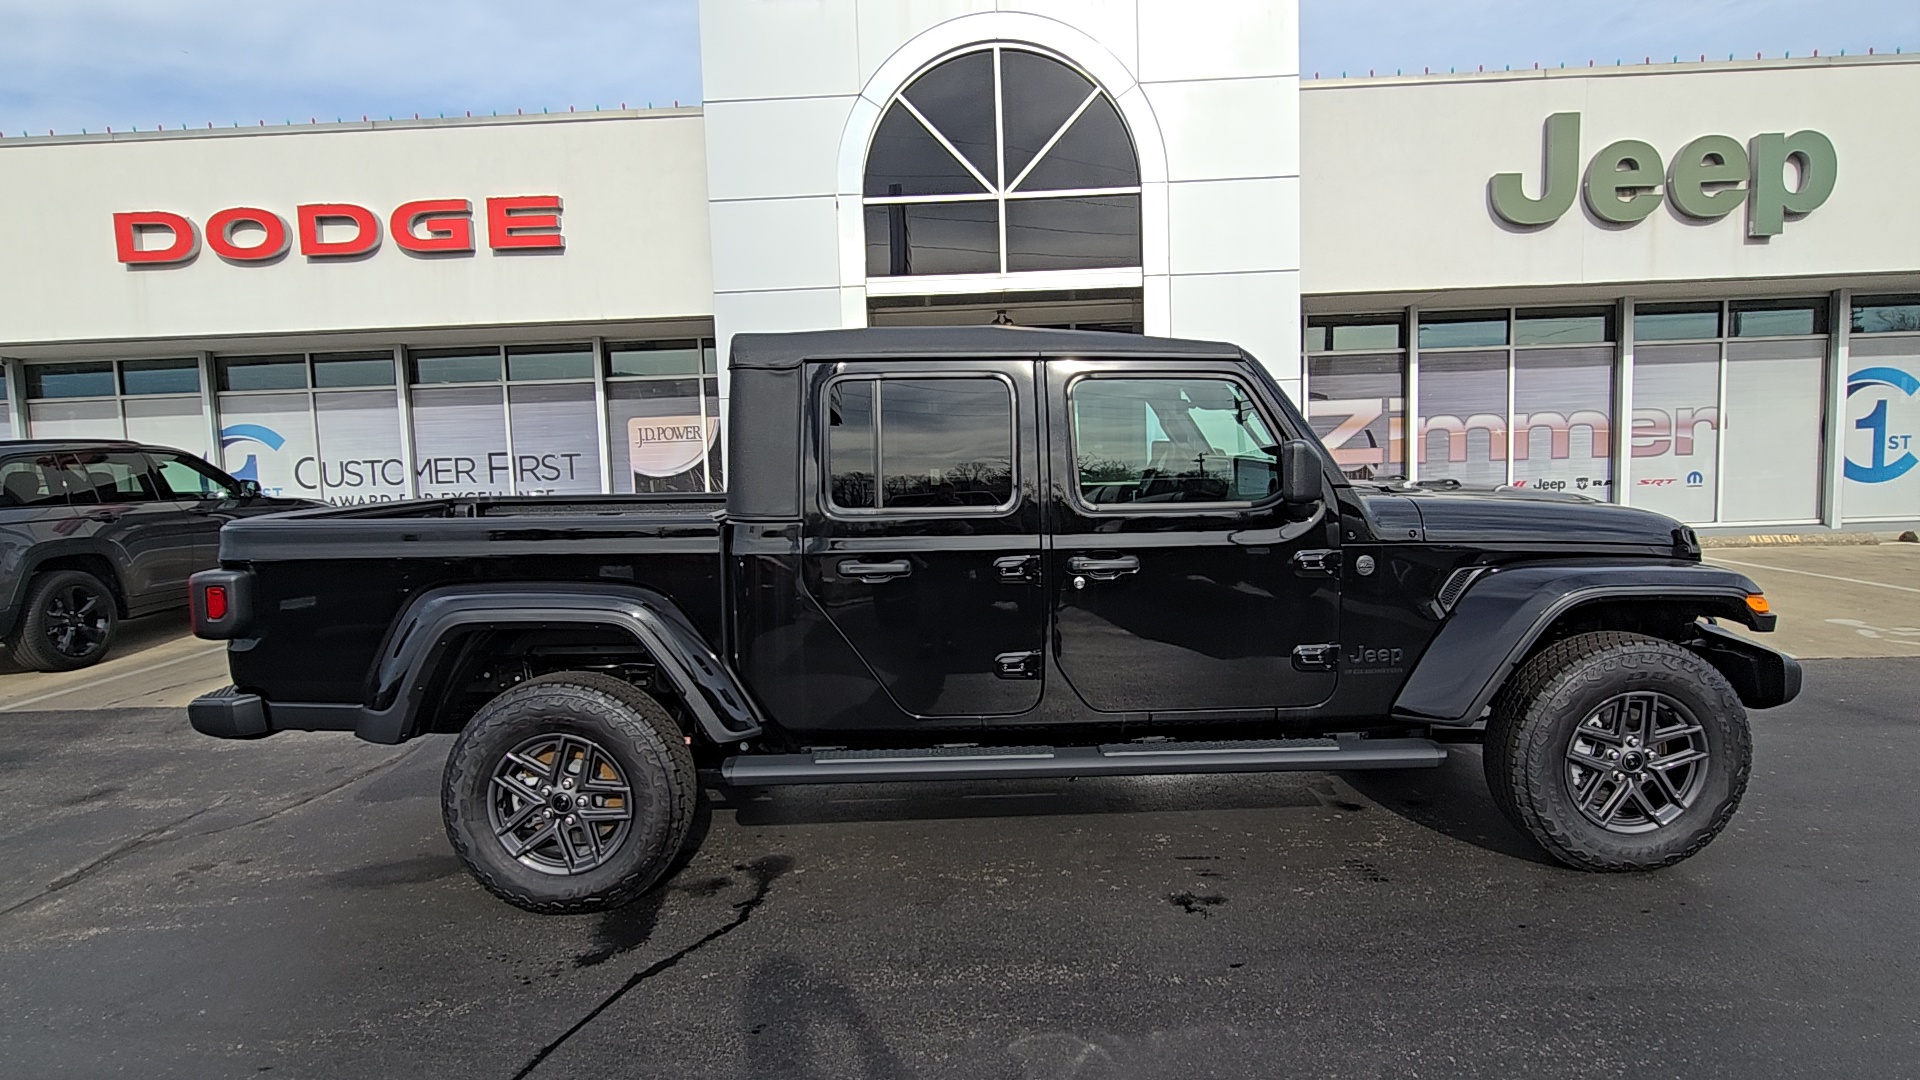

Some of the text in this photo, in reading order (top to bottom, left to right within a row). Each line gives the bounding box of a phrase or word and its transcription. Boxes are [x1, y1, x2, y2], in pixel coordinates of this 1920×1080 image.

[1487, 112, 1838, 236] Jeep
[112, 195, 563, 264] DODGE
[657, 425, 703, 441] POWER
[1308, 396, 1728, 466] Zimmer
[294, 452, 582, 489] CUSTOMER FIRST
[1533, 478, 1567, 492] Jeep
[1636, 478, 1678, 487] SRT
[1749, 534, 1801, 544] VISITOR
[1348, 645, 1403, 666] Jeep
